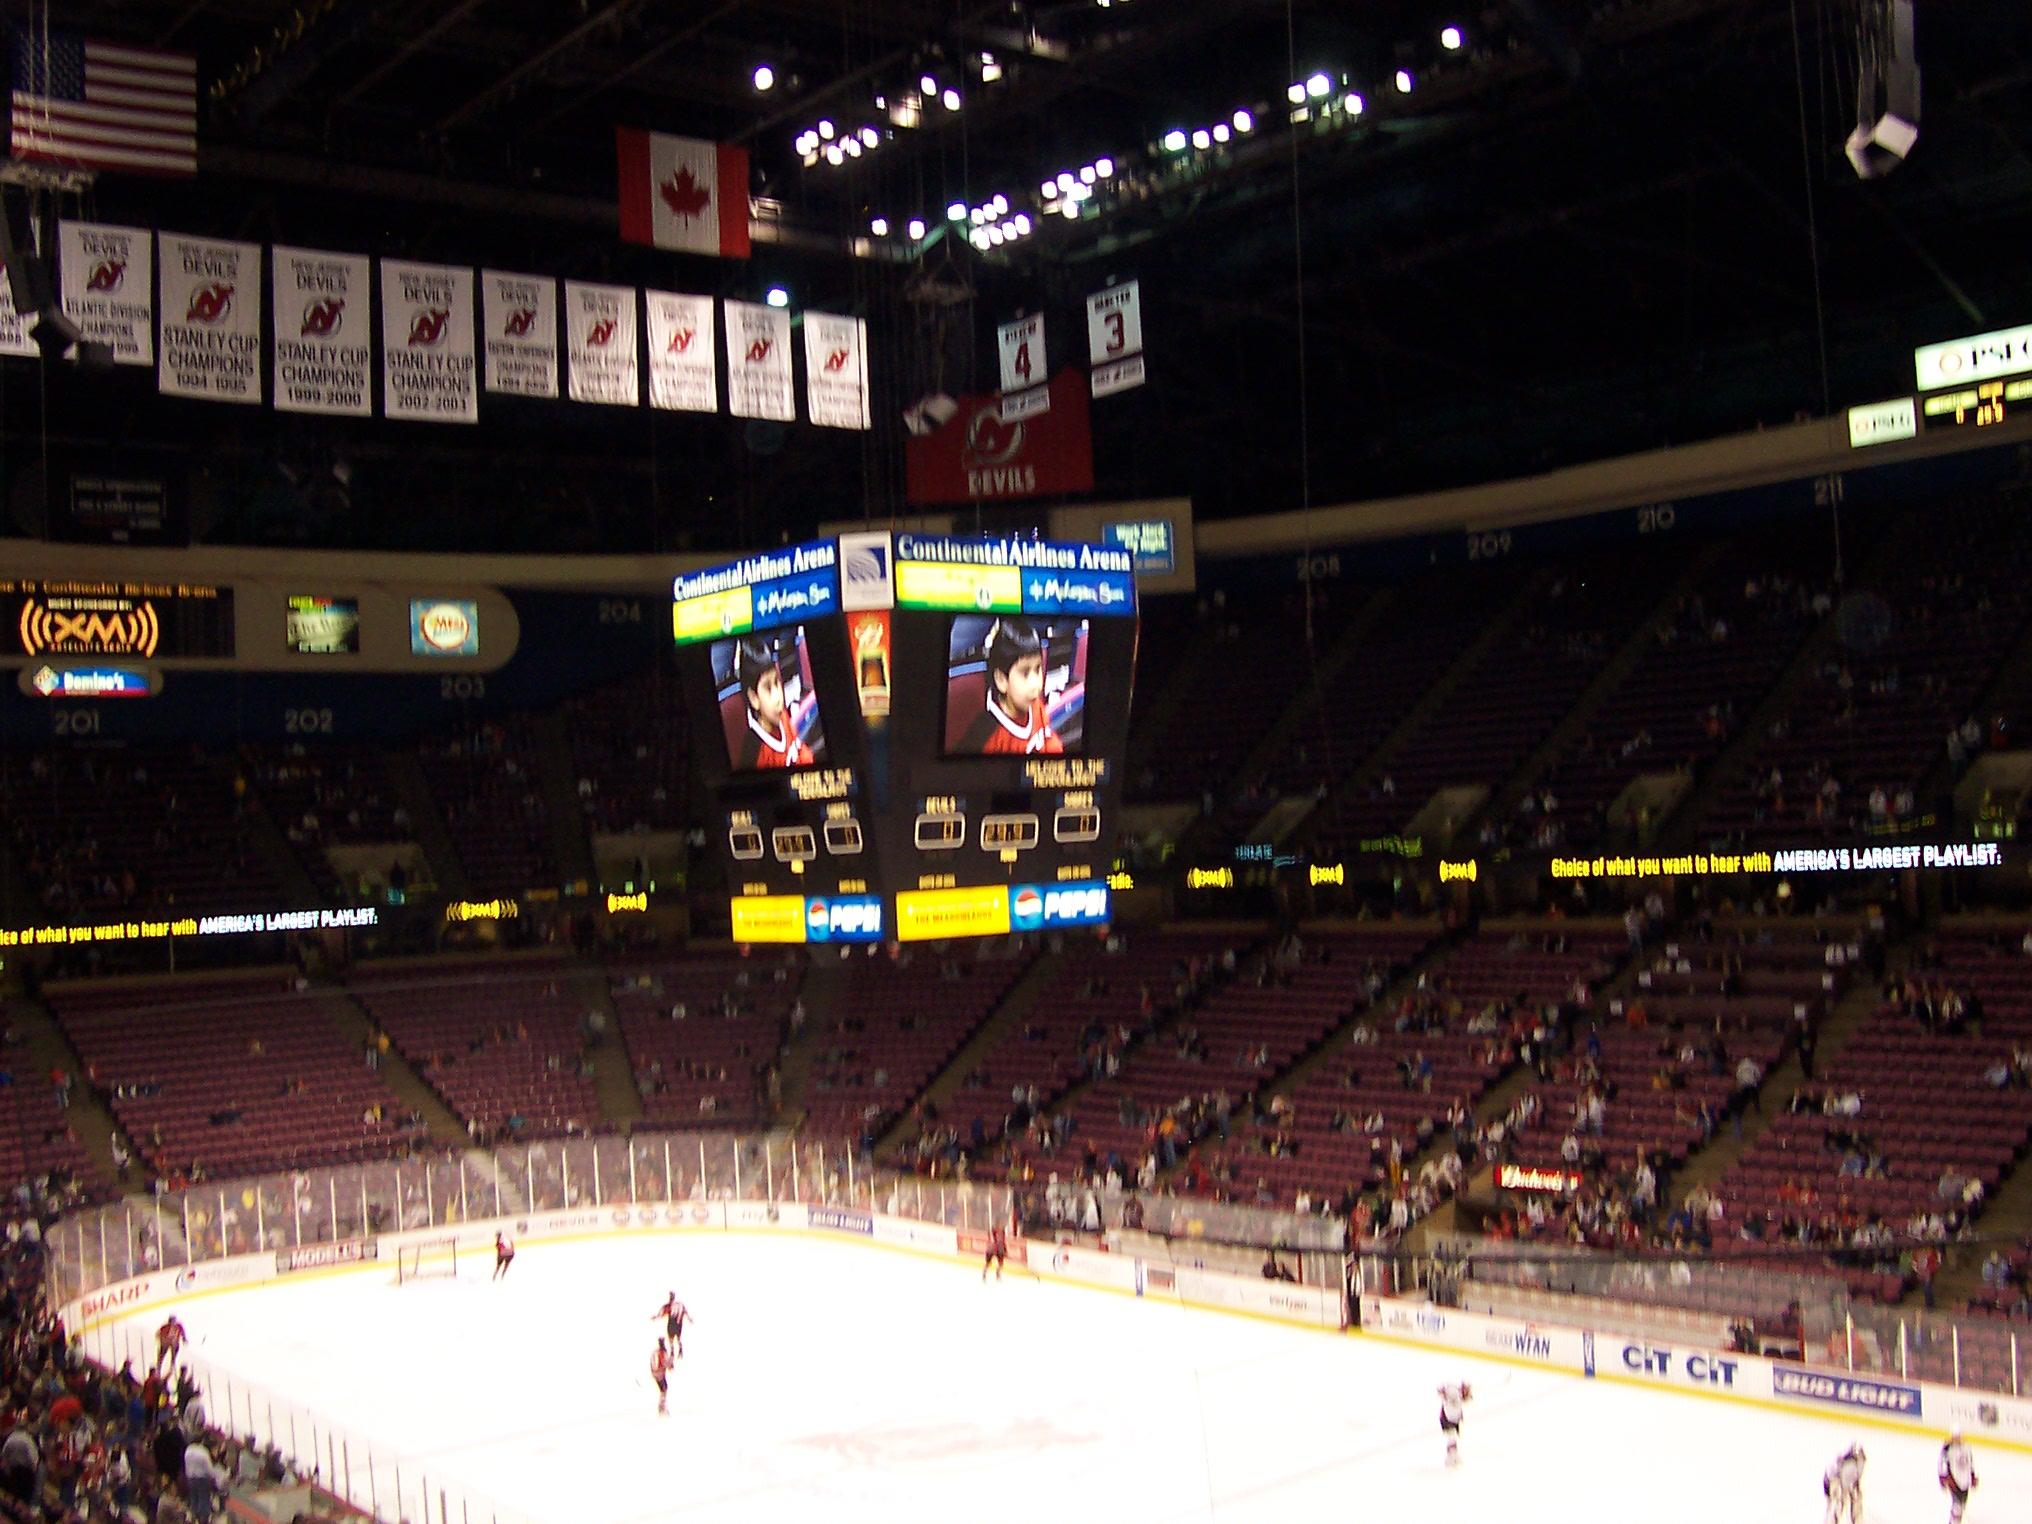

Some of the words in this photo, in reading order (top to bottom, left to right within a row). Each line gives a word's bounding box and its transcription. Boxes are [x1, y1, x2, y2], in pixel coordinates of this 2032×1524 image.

[184, 257, 237, 279] DEVILS
[297, 272, 347, 291] DEVILS
[404, 285, 452, 305] DEVILS
[164, 323, 225, 350] STANLEY
[229, 333, 258, 353] CUP
[1104, 312, 1125, 353] 3
[168, 351, 254, 377] CHAMPIONS
[278, 341, 338, 365] STANLEY
[341, 347, 368, 368] CUP
[387, 350, 443, 371] STANLEY
[447, 354, 473, 374] CUP
[1015, 341, 1031, 382] 4
[282, 366, 364, 390] CHAMPIONS
[392, 372, 470, 394] CHAMPIONS
[898, 535, 1008, 565] Continental
[1009, 539, 1076, 569] Airlines
[1080, 544, 1130, 571] Arena
[674, 561, 742, 601] Continental
[743, 555, 791, 585] Airlines
[793, 545, 835, 574] Arena
[43, 581, 119, 596] Continental
[53, 612, 128, 646] XM
[63, 671, 125, 691] Domino's
[55, 708, 100, 736] 201
[284, 707, 333, 734] 202
[1551, 857, 1590, 878] Choice
[1592, 857, 1604, 877] of
[1607, 856, 1636, 876] what
[1638, 858, 1660, 879] you
[1662, 854, 1692, 875] want
[1695, 854, 1708, 874] to
[1710, 853, 1741, 874] hear
[1743, 851, 1771, 873] with
[1774, 848, 1850, 872] AMERICA'S
[1853, 846, 1920, 869] LARGEST
[830, 904, 881, 932] PEPSI
[1045, 888, 1107, 920] PEPSI
[21, 927, 34, 944] of
[36, 926, 67, 943] what
[69, 927, 92, 944] you
[94, 923, 125, 940] want
[127, 922, 139, 939] to
[141, 921, 169, 937] hear
[171, 918, 197, 935] with
[199, 914, 264, 934] AMERICA'S
[266, 911, 319, 930] LARGEST
[1837, 1380, 1914, 1411] LIGHT
